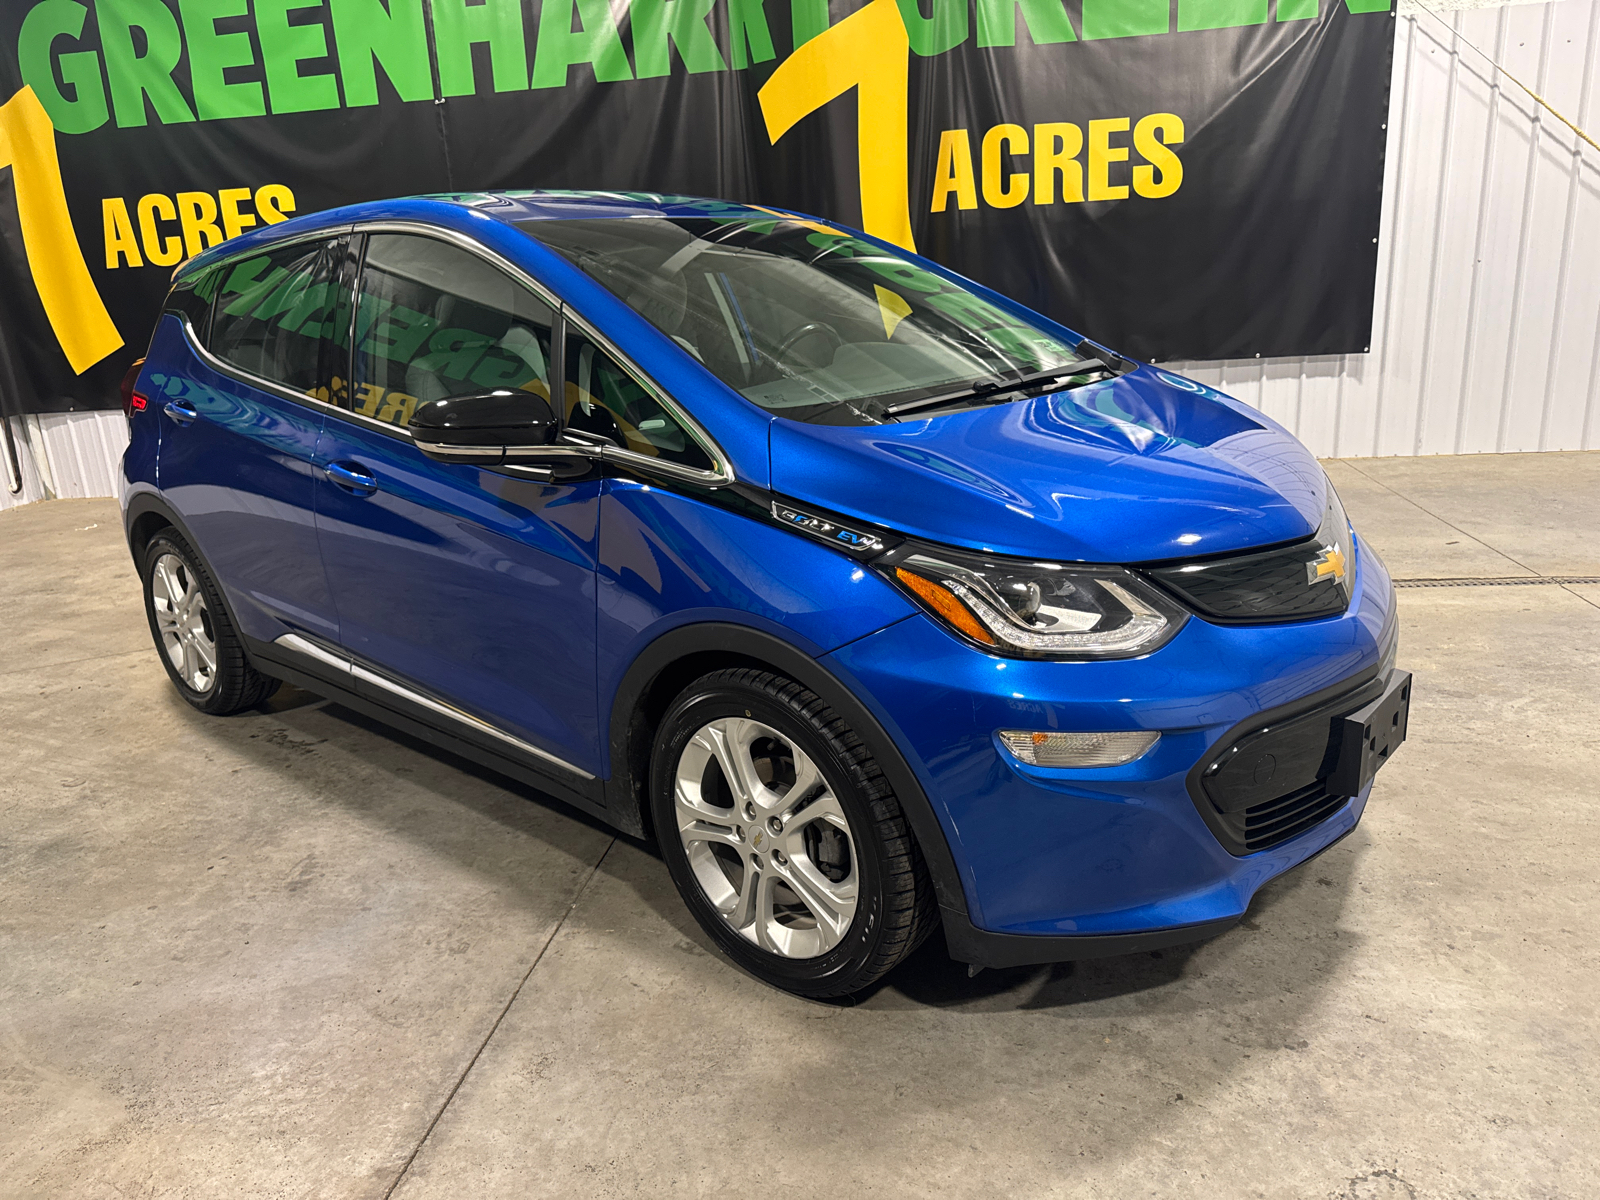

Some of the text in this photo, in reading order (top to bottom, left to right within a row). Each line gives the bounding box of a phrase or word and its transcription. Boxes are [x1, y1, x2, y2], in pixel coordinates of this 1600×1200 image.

[756, 0, 1185, 254] 7 ACRES
[102, 184, 297, 269] ACRES
